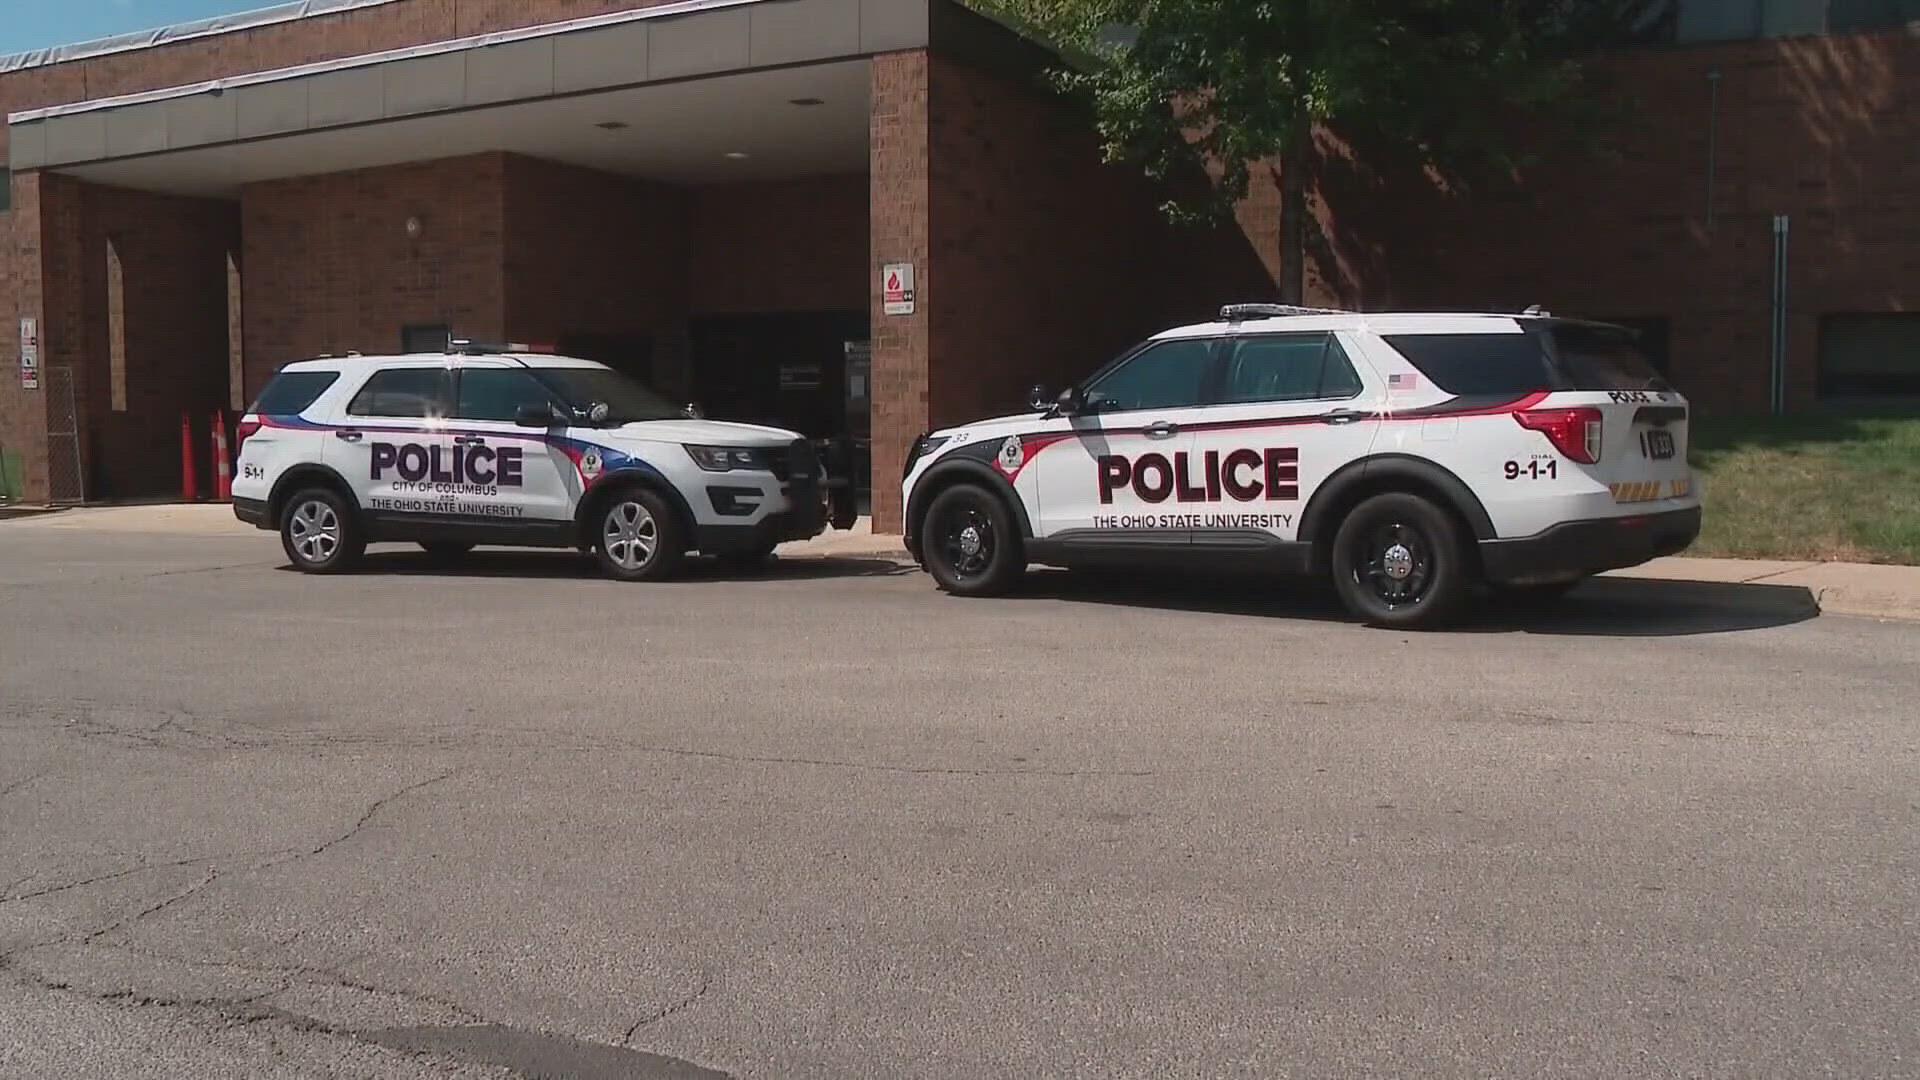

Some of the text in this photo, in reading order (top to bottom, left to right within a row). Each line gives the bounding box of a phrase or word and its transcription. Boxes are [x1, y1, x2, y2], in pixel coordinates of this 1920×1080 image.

[245, 466, 264, 480] 9-1-1
[370, 442, 523, 487] POLICE
[1504, 460, 1557, 480] 9-1-1
[1097, 447, 1299, 504] POLICE
[392, 481, 497, 496] CITY OF COLUMBUS
[371, 498, 524, 516] THE OHIO STATE UNIVERSITY
[1093, 514, 1293, 529] THE OHIO STATE UNIVERSITY
